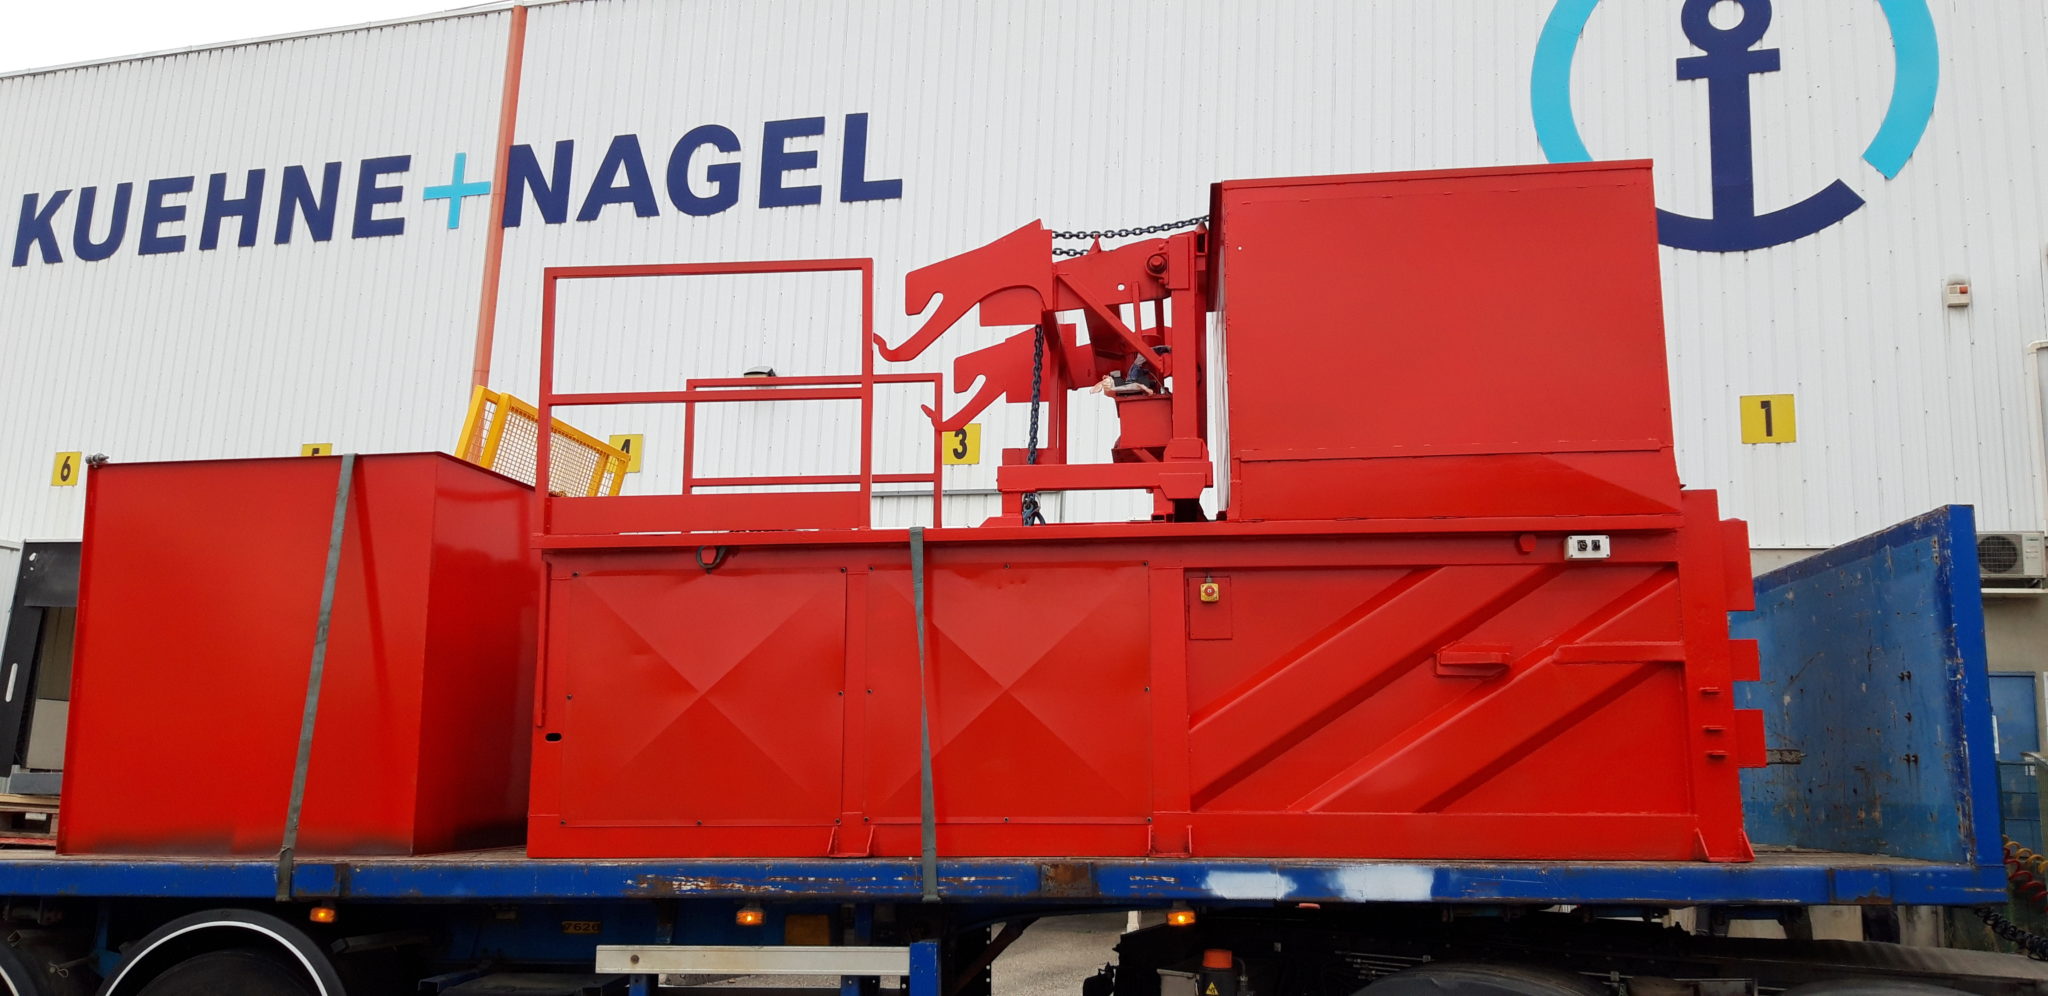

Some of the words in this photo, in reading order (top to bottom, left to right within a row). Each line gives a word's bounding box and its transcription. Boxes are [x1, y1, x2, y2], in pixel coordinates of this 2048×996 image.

[1760, 400, 1772, 437] 1
[953, 428, 967, 459] 3
[60, 456, 71, 482] 6
